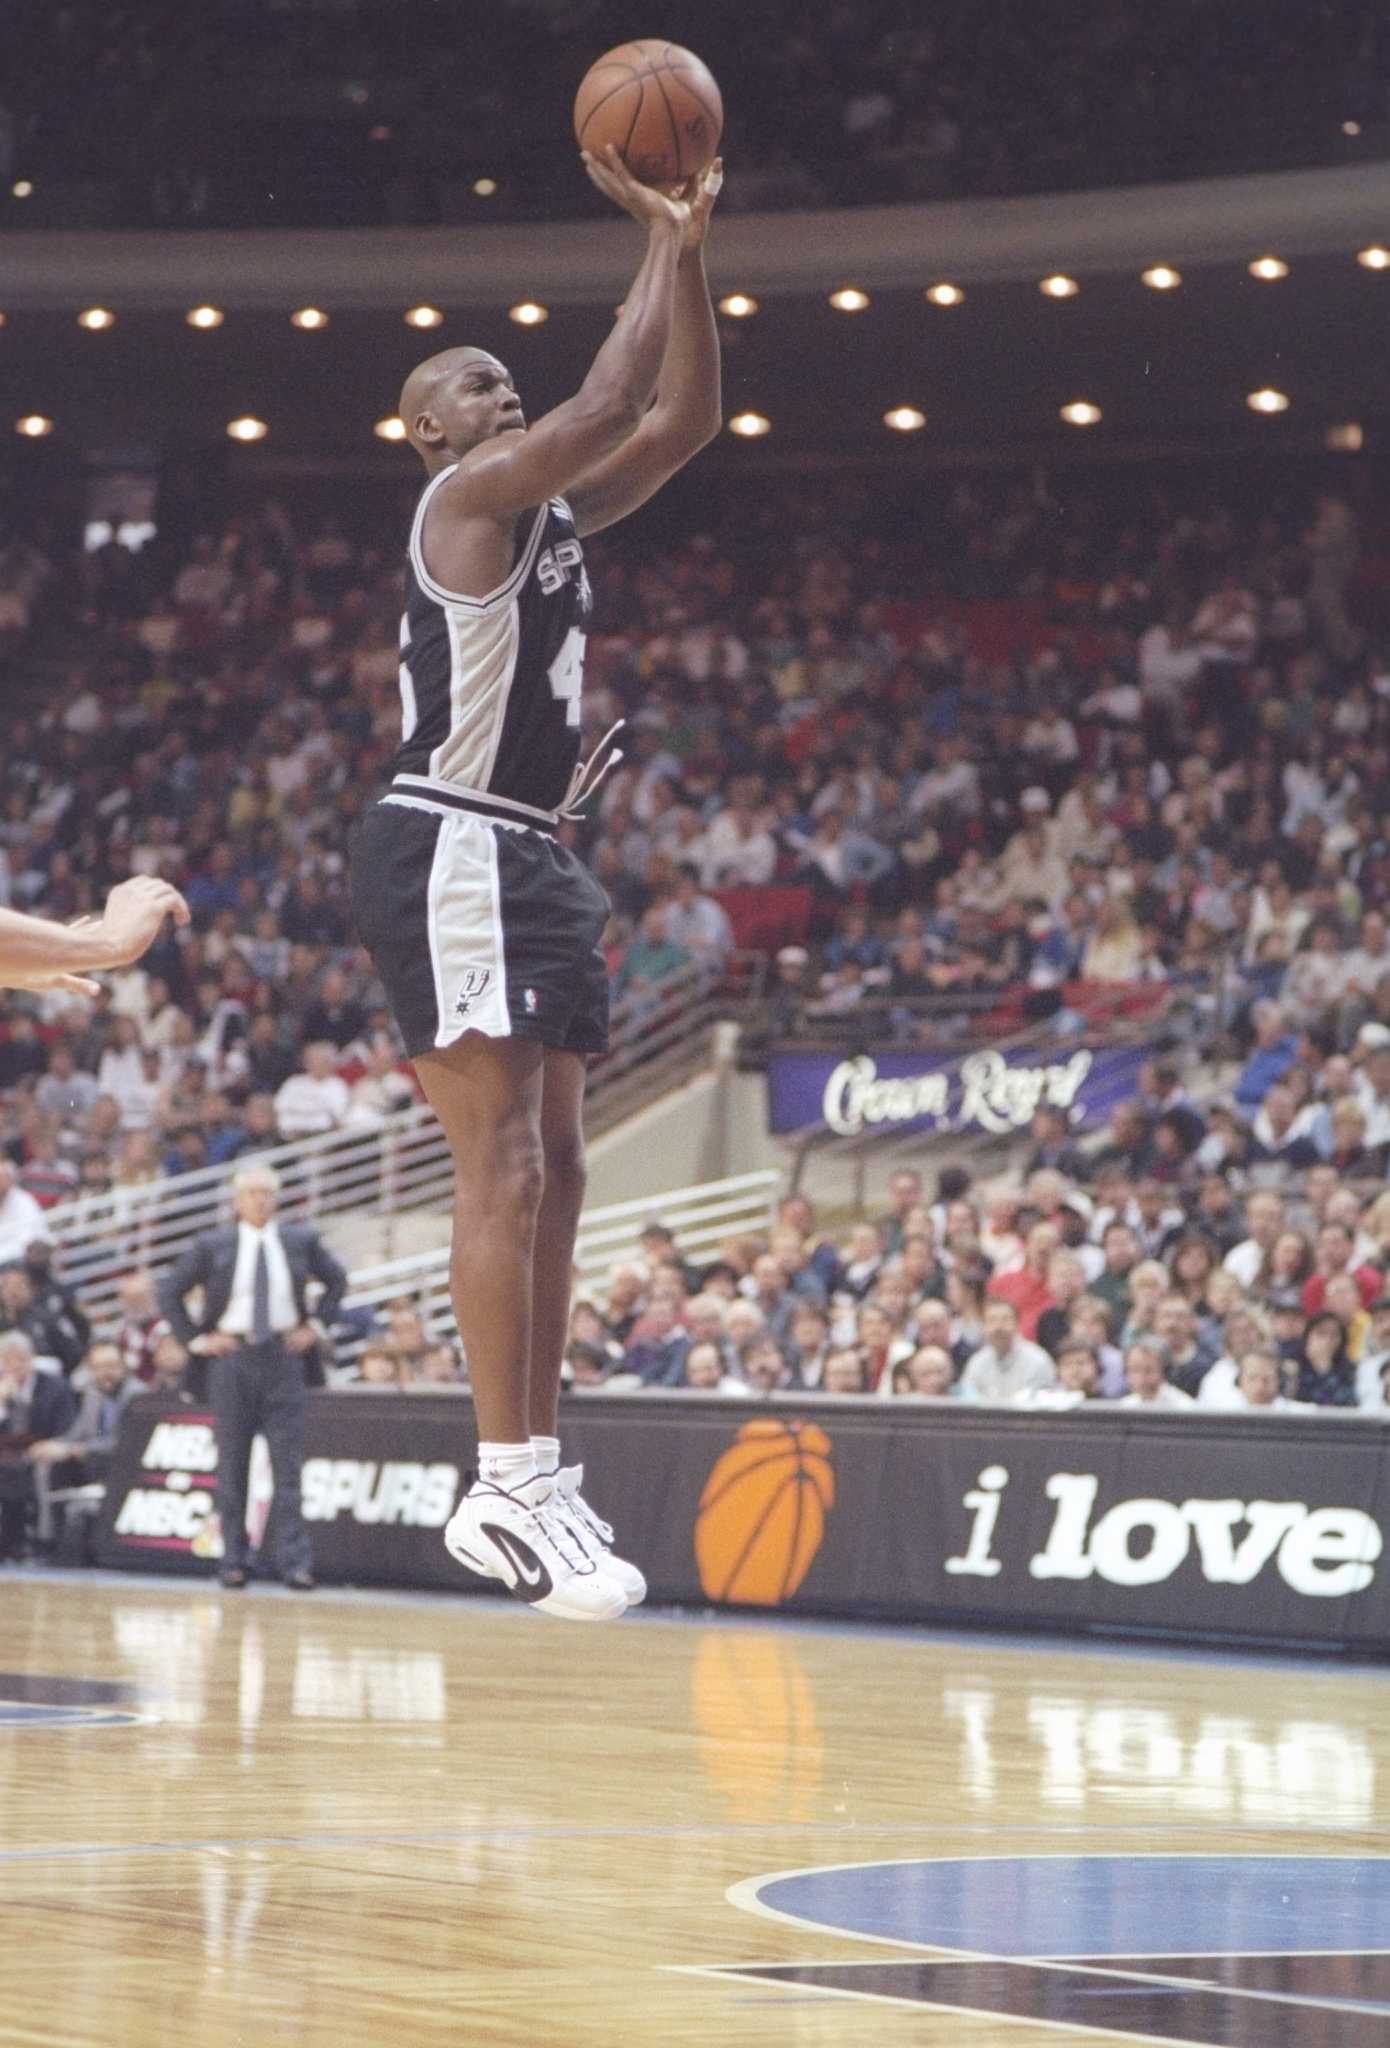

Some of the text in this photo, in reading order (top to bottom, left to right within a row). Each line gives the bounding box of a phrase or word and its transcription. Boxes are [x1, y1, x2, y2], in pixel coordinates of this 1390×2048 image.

[547, 625, 586, 726] 4
[823, 1054, 950, 1135] Crown
[301, 1458, 458, 1527] SPURS
[944, 1465, 1382, 1597] i love
